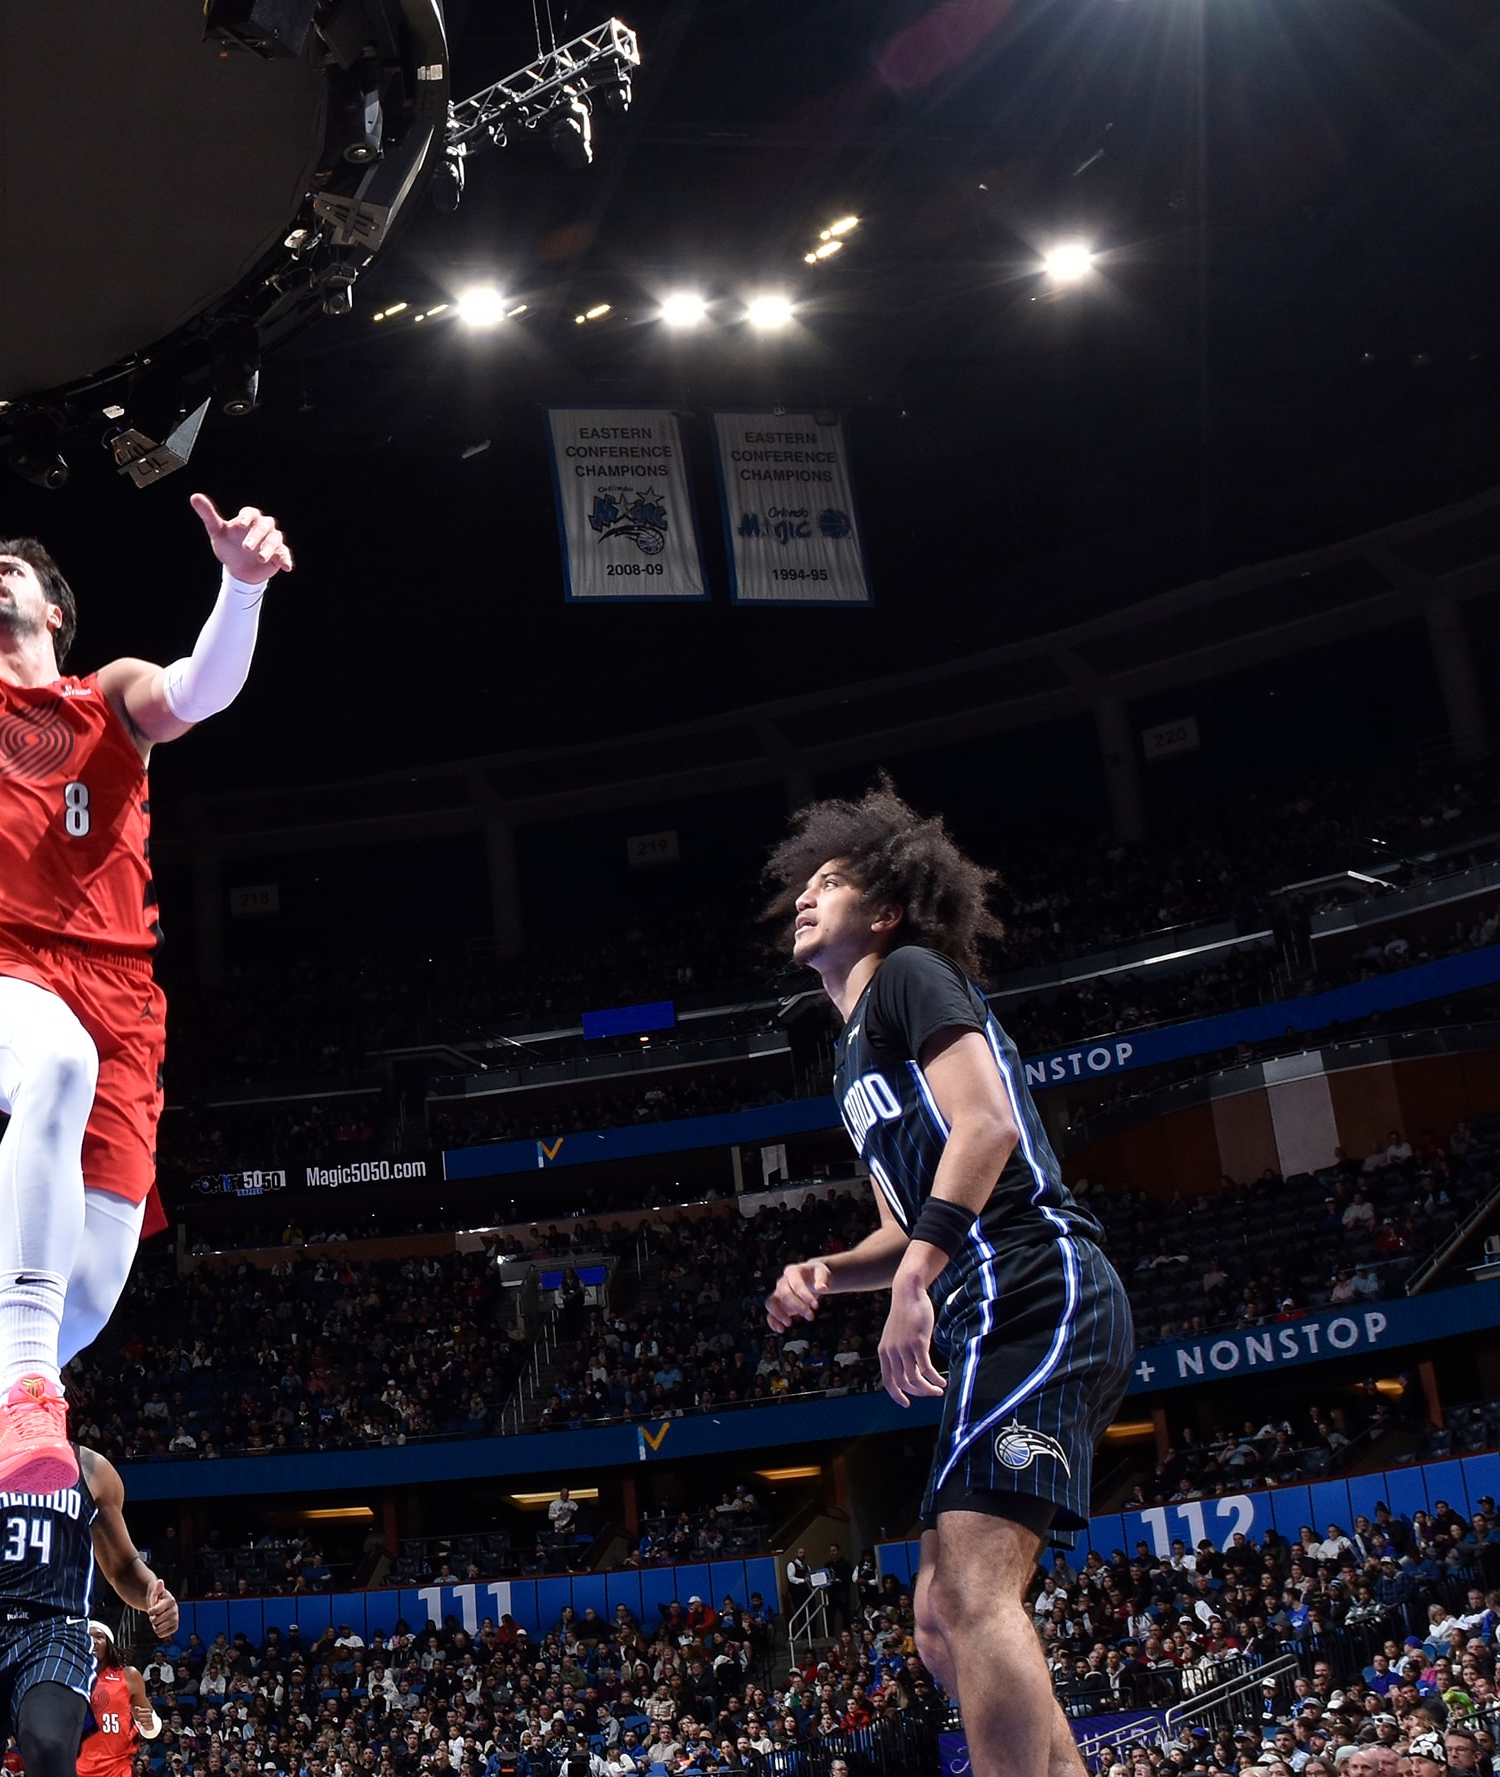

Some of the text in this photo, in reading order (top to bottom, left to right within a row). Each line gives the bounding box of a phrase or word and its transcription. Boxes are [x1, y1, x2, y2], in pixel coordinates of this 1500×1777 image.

[579, 427, 652, 439] EASTERN
[745, 431, 817, 444] EASTERN
[566, 446, 672, 458] CONFERENCE
[731, 450, 837, 463] CONFERENCE
[575, 465, 668, 477] CHAMPIONS
[740, 469, 833, 482] CHAMPIONS
[768, 507, 809, 518] Orlndo
[738, 514, 812, 545] Mgic
[607, 564, 663, 576] 2008-09
[772, 569, 828, 581] 1994-95
[63, 781, 91, 838] 8
[1024, 1043, 1133, 1086] NSTOP
[306, 1160, 427, 1188] Magic5050.com
[1176, 1311, 1388, 1378] NONSTOP
[1141, 1494, 1254, 1561] 112
[3, 1516, 52, 1565] 34
[418, 1581, 512, 1640] 111
[102, 1713, 120, 1734] 35
